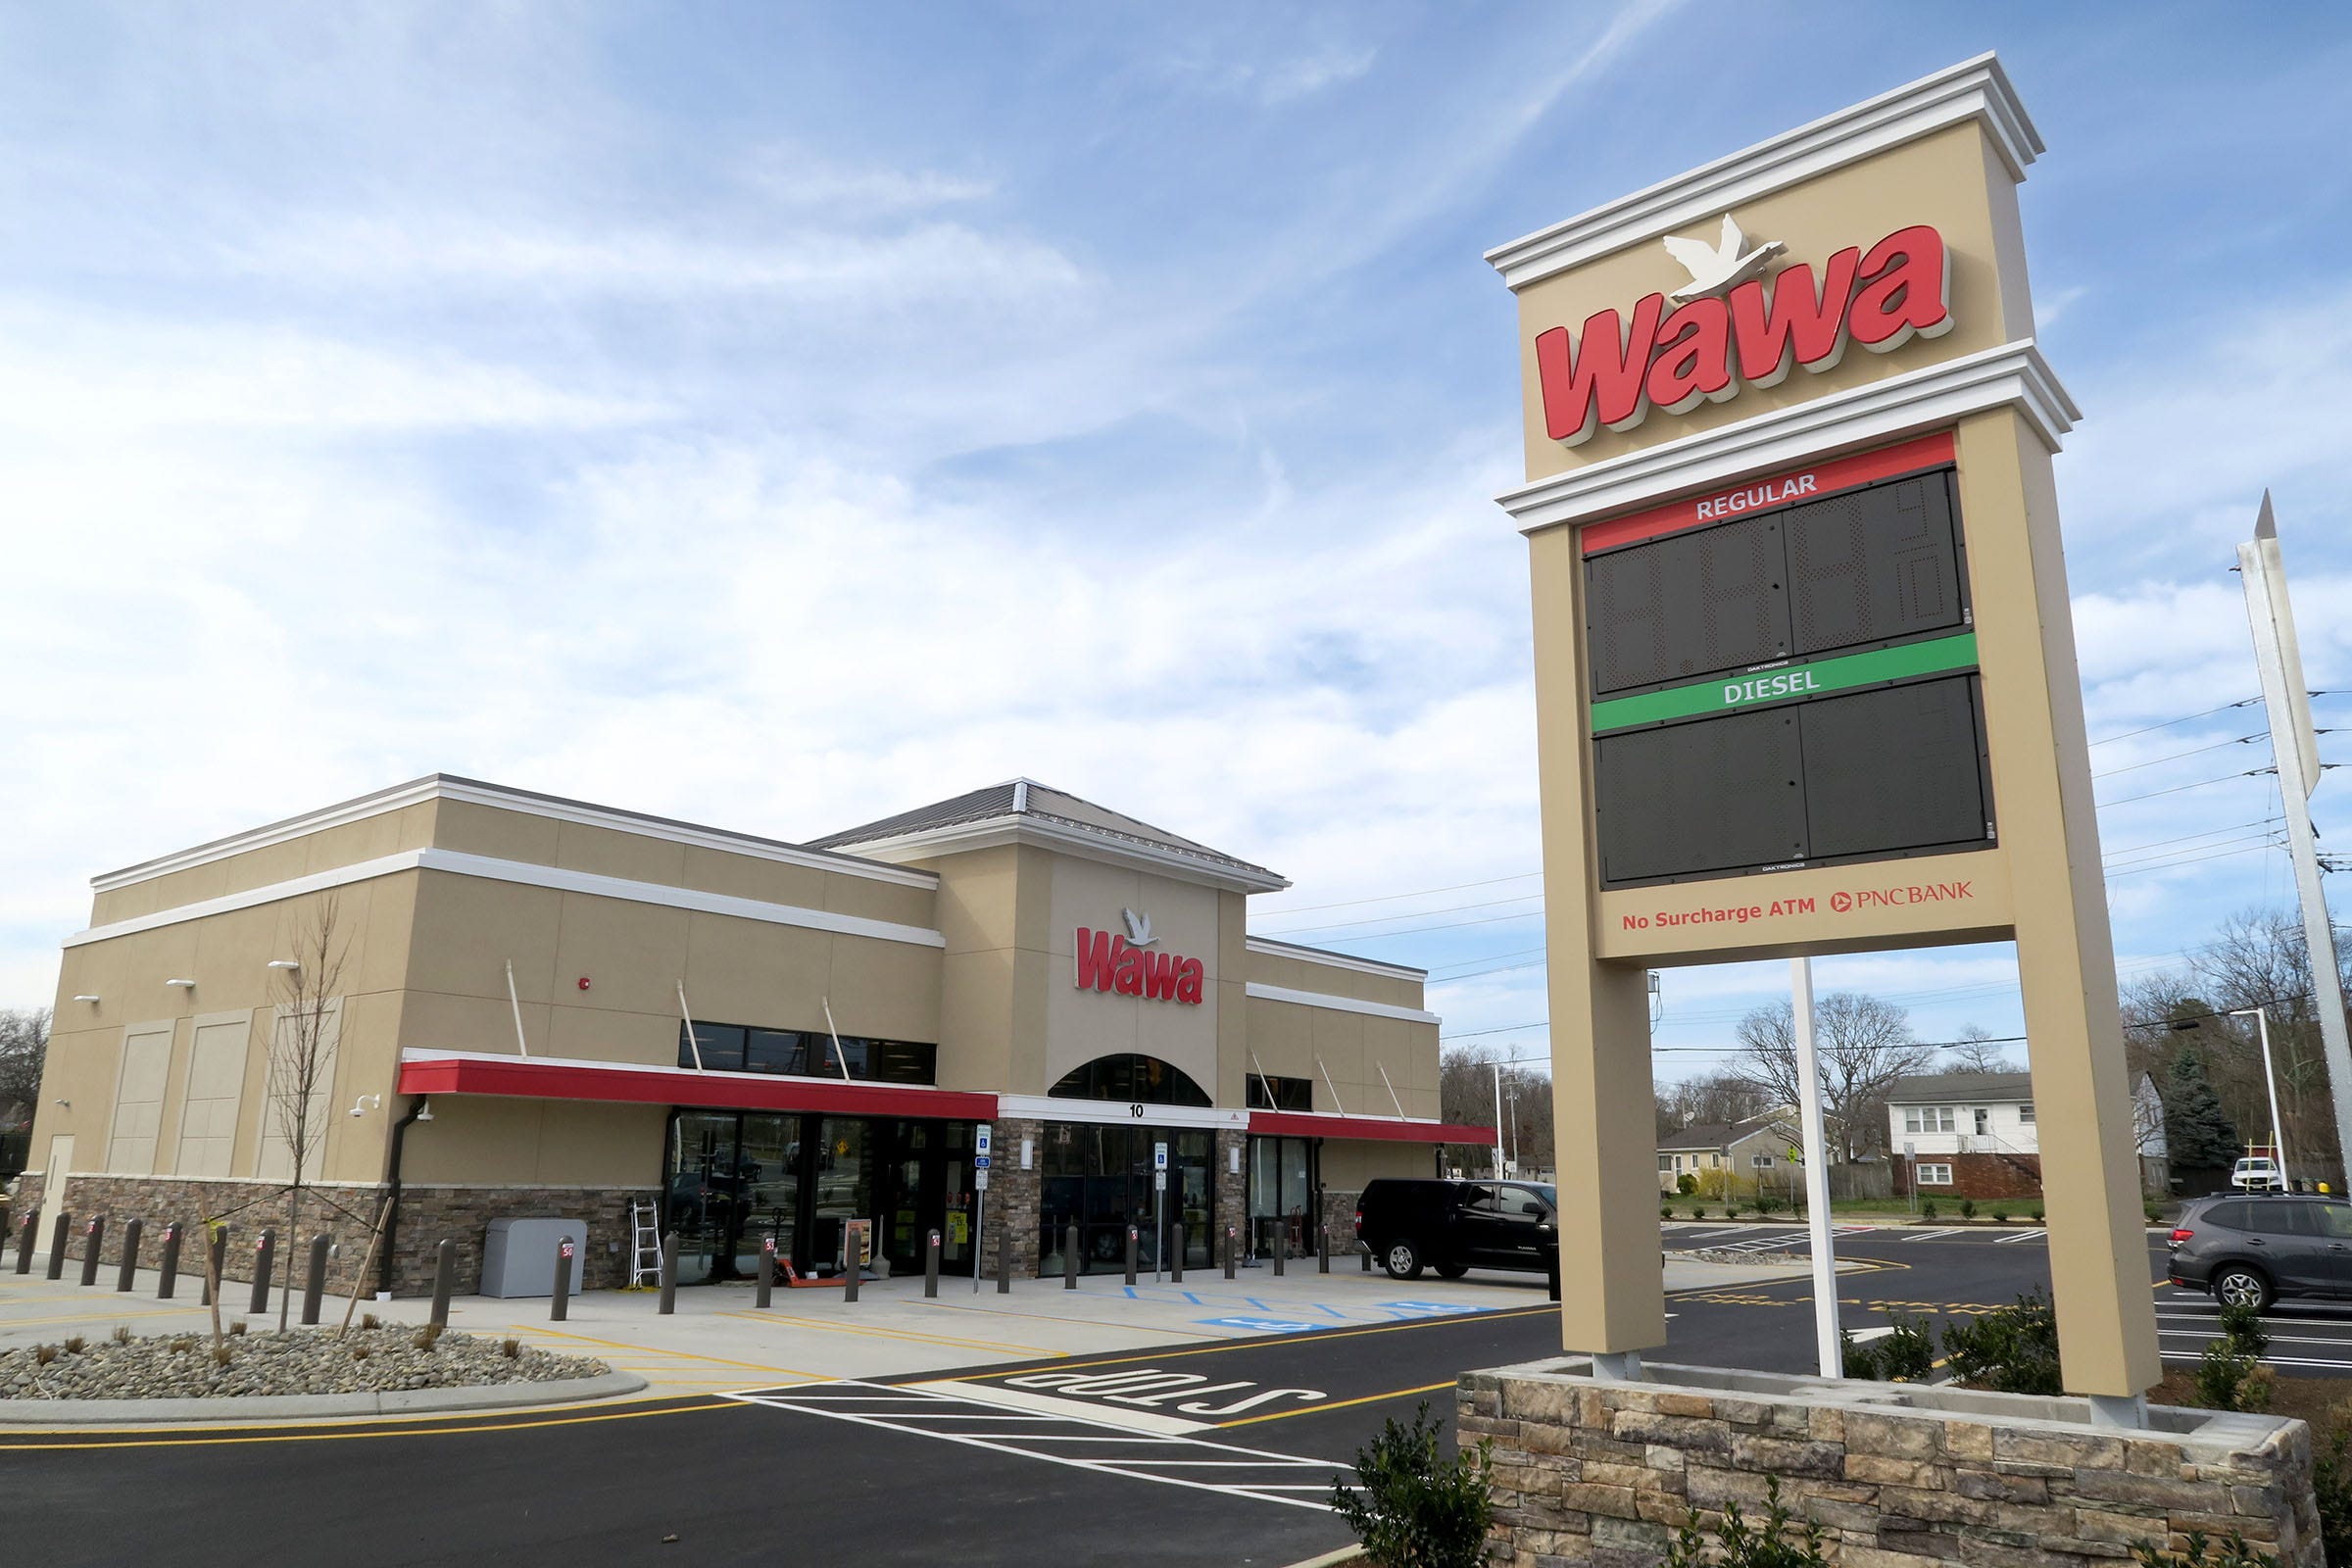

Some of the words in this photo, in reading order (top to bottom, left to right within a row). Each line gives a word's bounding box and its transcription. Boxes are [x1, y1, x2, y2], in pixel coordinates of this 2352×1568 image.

[1536, 224, 1954, 446] Wawa
[1696, 473, 1818, 520] REGULAR
[1724, 670, 1820, 704] DIESEL
[1622, 912, 1649, 930] No
[1655, 905, 1763, 928] Surcharge
[1769, 898, 1816, 917] ATM
[1074, 927, 1203, 1004] Wawa
[1129, 1103, 1144, 1118] 10
[564, 1248, 573, 1256] 50
[1004, 1369, 1327, 1414] STOP
